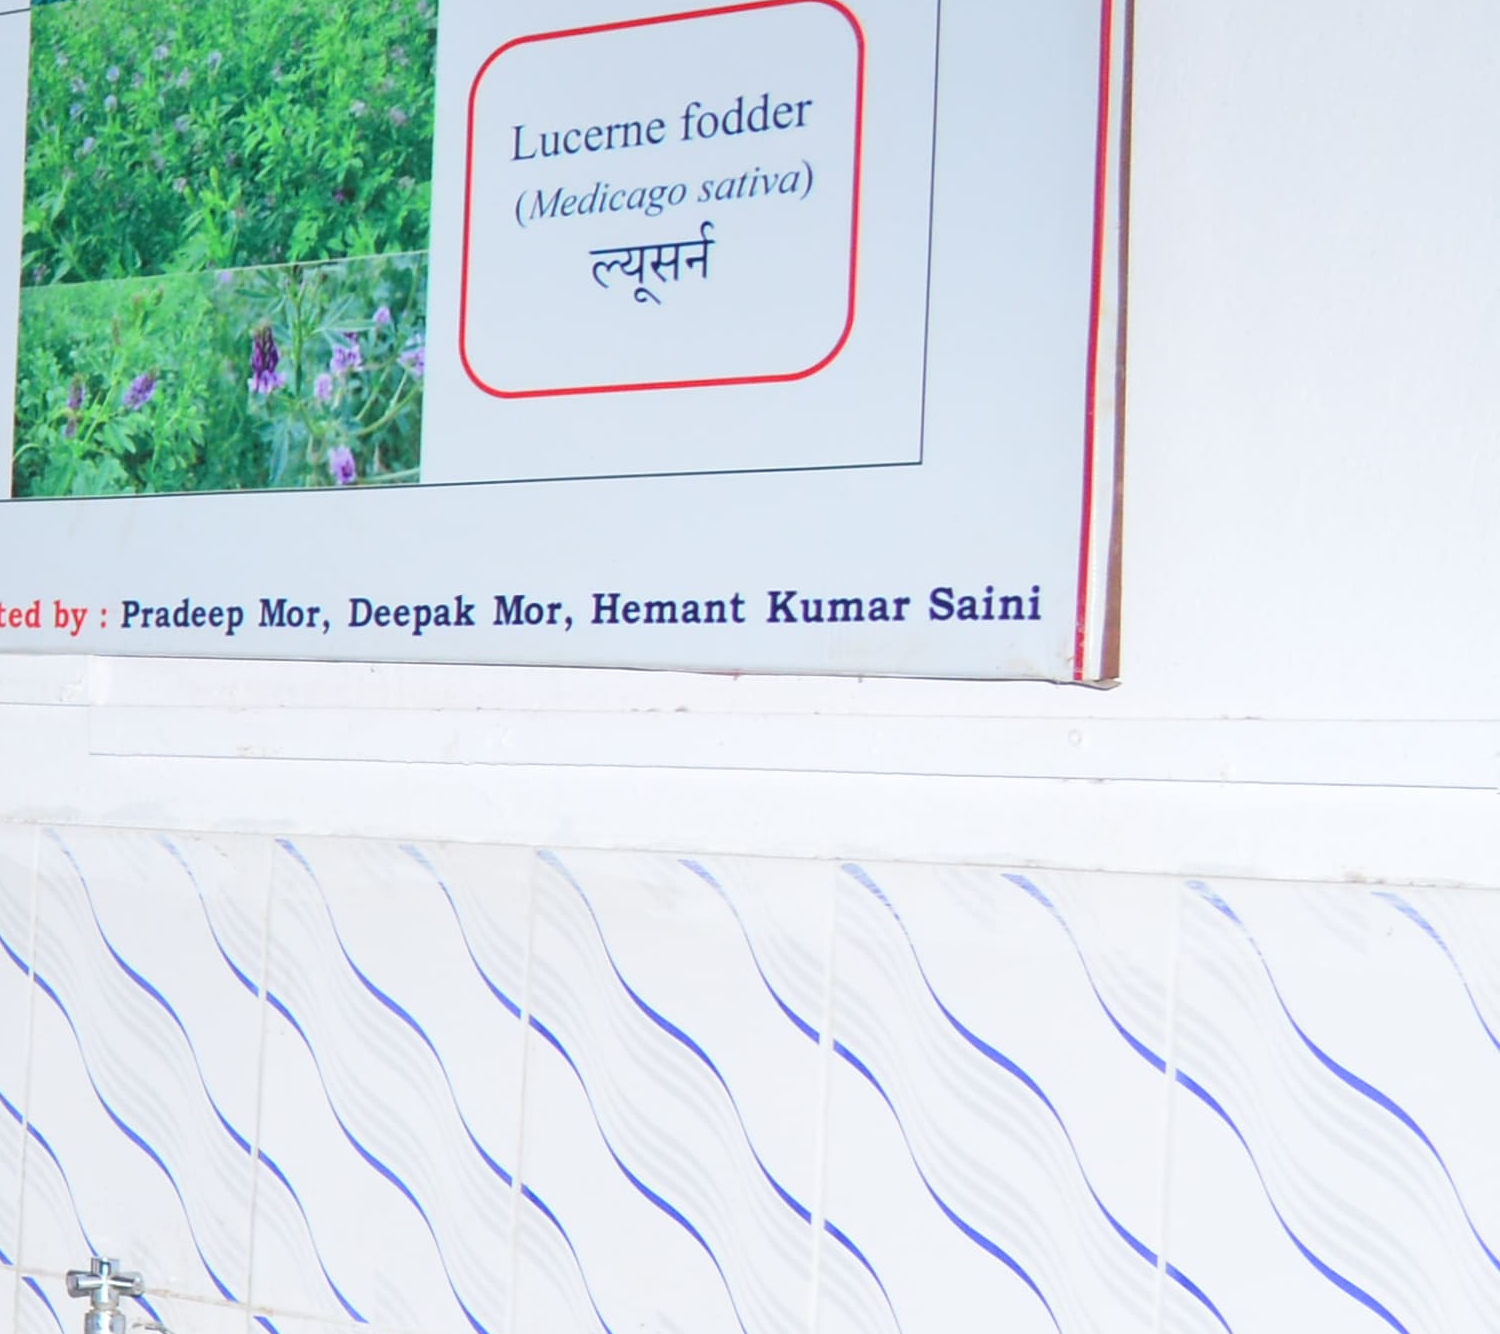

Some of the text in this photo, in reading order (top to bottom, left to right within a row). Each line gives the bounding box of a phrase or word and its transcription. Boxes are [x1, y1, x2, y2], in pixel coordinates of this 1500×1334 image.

[510, 93, 814, 161] Lucerne fodder
[515, 159, 814, 228] (Medicago sativa)
[589, 220, 716, 305] ल्यूसर्न
[53, 600, 88, 635] by
[100, 607, 107, 629] :
[120, 598, 244, 635] Pradeep
[258, 598, 330, 634] Mor,
[348, 595, 476, 635] Deepak
[493, 595, 574, 632] Mor,
[591, 592, 746, 624] Hemant
[766, 590, 911, 623] Kumar
[928, 584, 1041, 621] Saini
